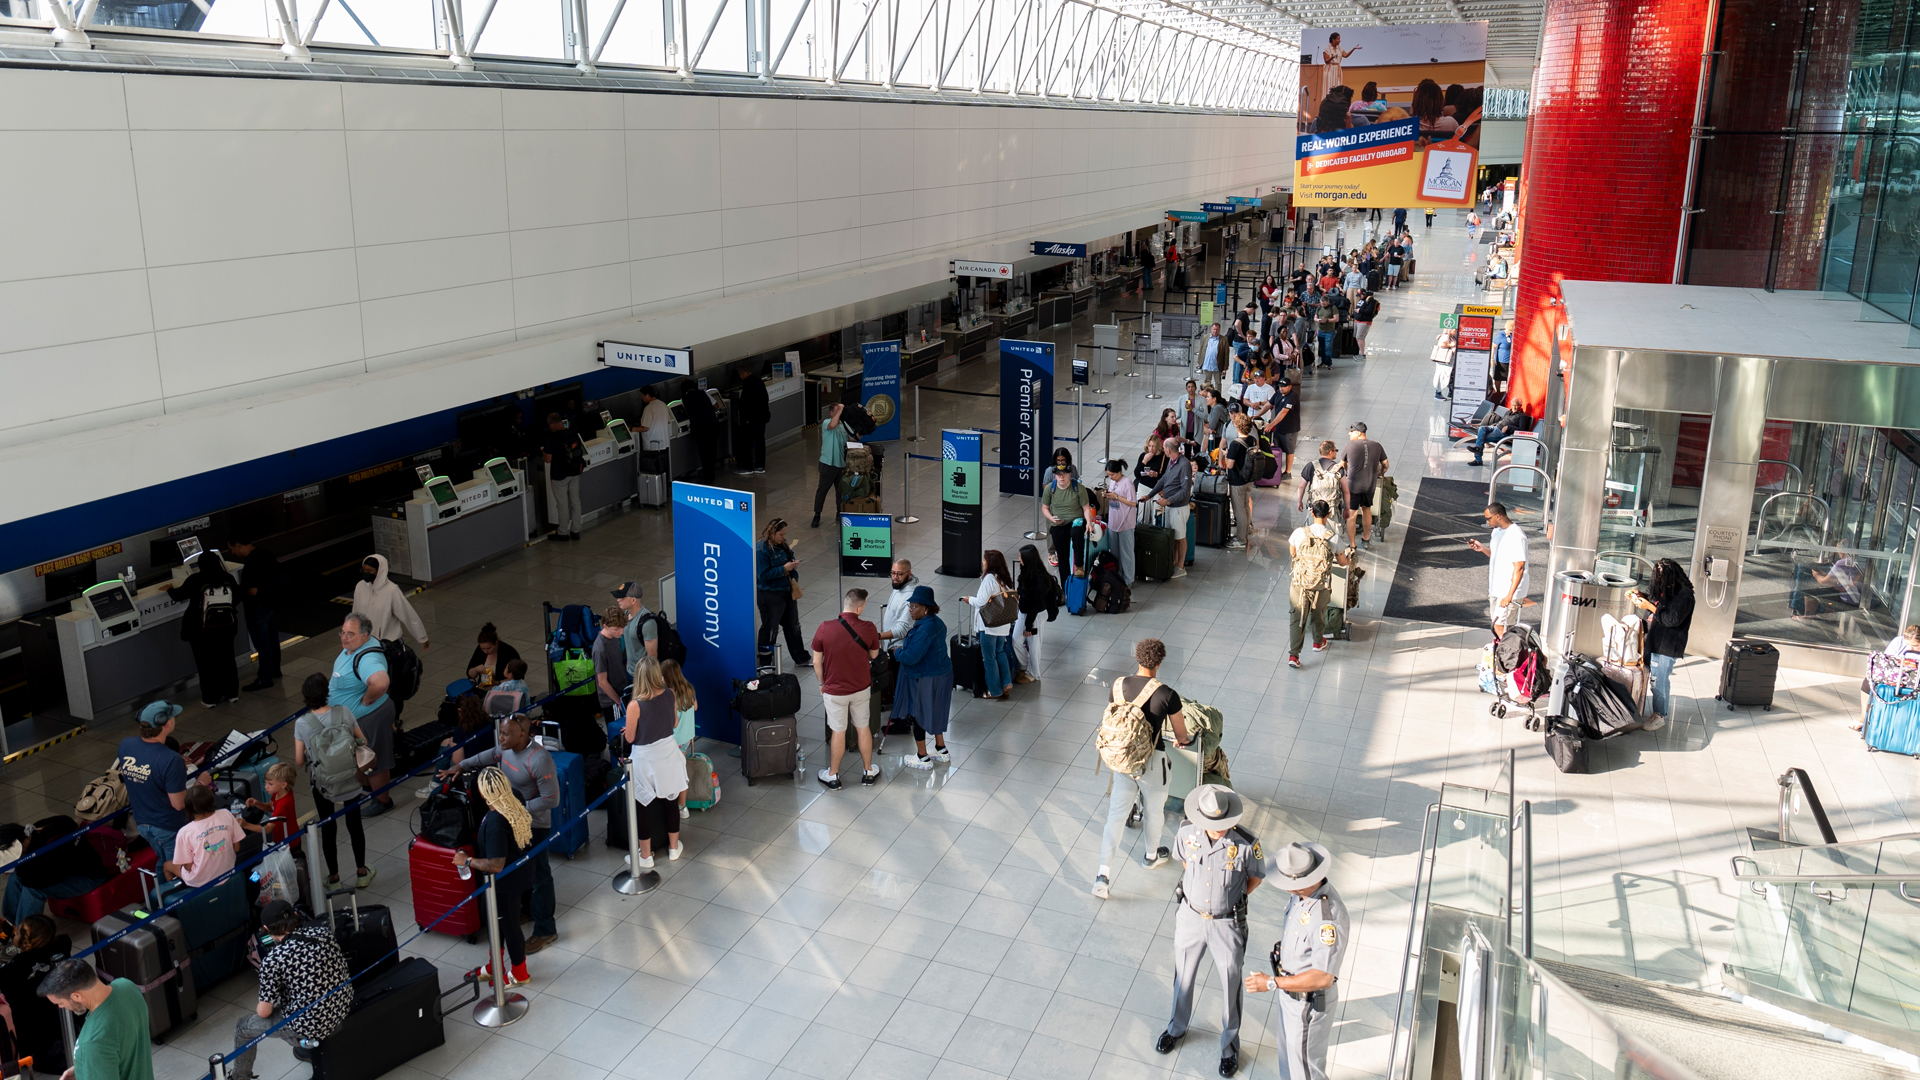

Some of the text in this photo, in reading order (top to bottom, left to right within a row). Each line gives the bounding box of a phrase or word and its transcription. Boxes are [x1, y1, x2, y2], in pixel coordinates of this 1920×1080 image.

[1301, 124, 1413, 152] REAL-WORLD EXPERIENCE
[1315, 147, 1407, 168] DEDICATED FACULTY ONBOARD
[1427, 177, 1463, 187] MORGAN
[1299, 191, 1368, 201] Visit morgan.edu
[1044, 243, 1076, 255] Alaska
[1466, 306, 1499, 314] Directory
[865, 346, 890, 354] UNITED
[616, 351, 662, 364] UNITED
[1020, 368, 1033, 429] Premier
[461, 493, 482, 504] NITED
[686, 495, 723, 507] UNITED
[35, 562, 55, 577] PLACE
[54, 556, 76, 572] ROLLER
[75, 552, 91, 566] BAGS
[702, 542, 721, 649] Economy
[1571, 595, 1597, 608] BWI
[122, 755, 152, 776] Pancho
